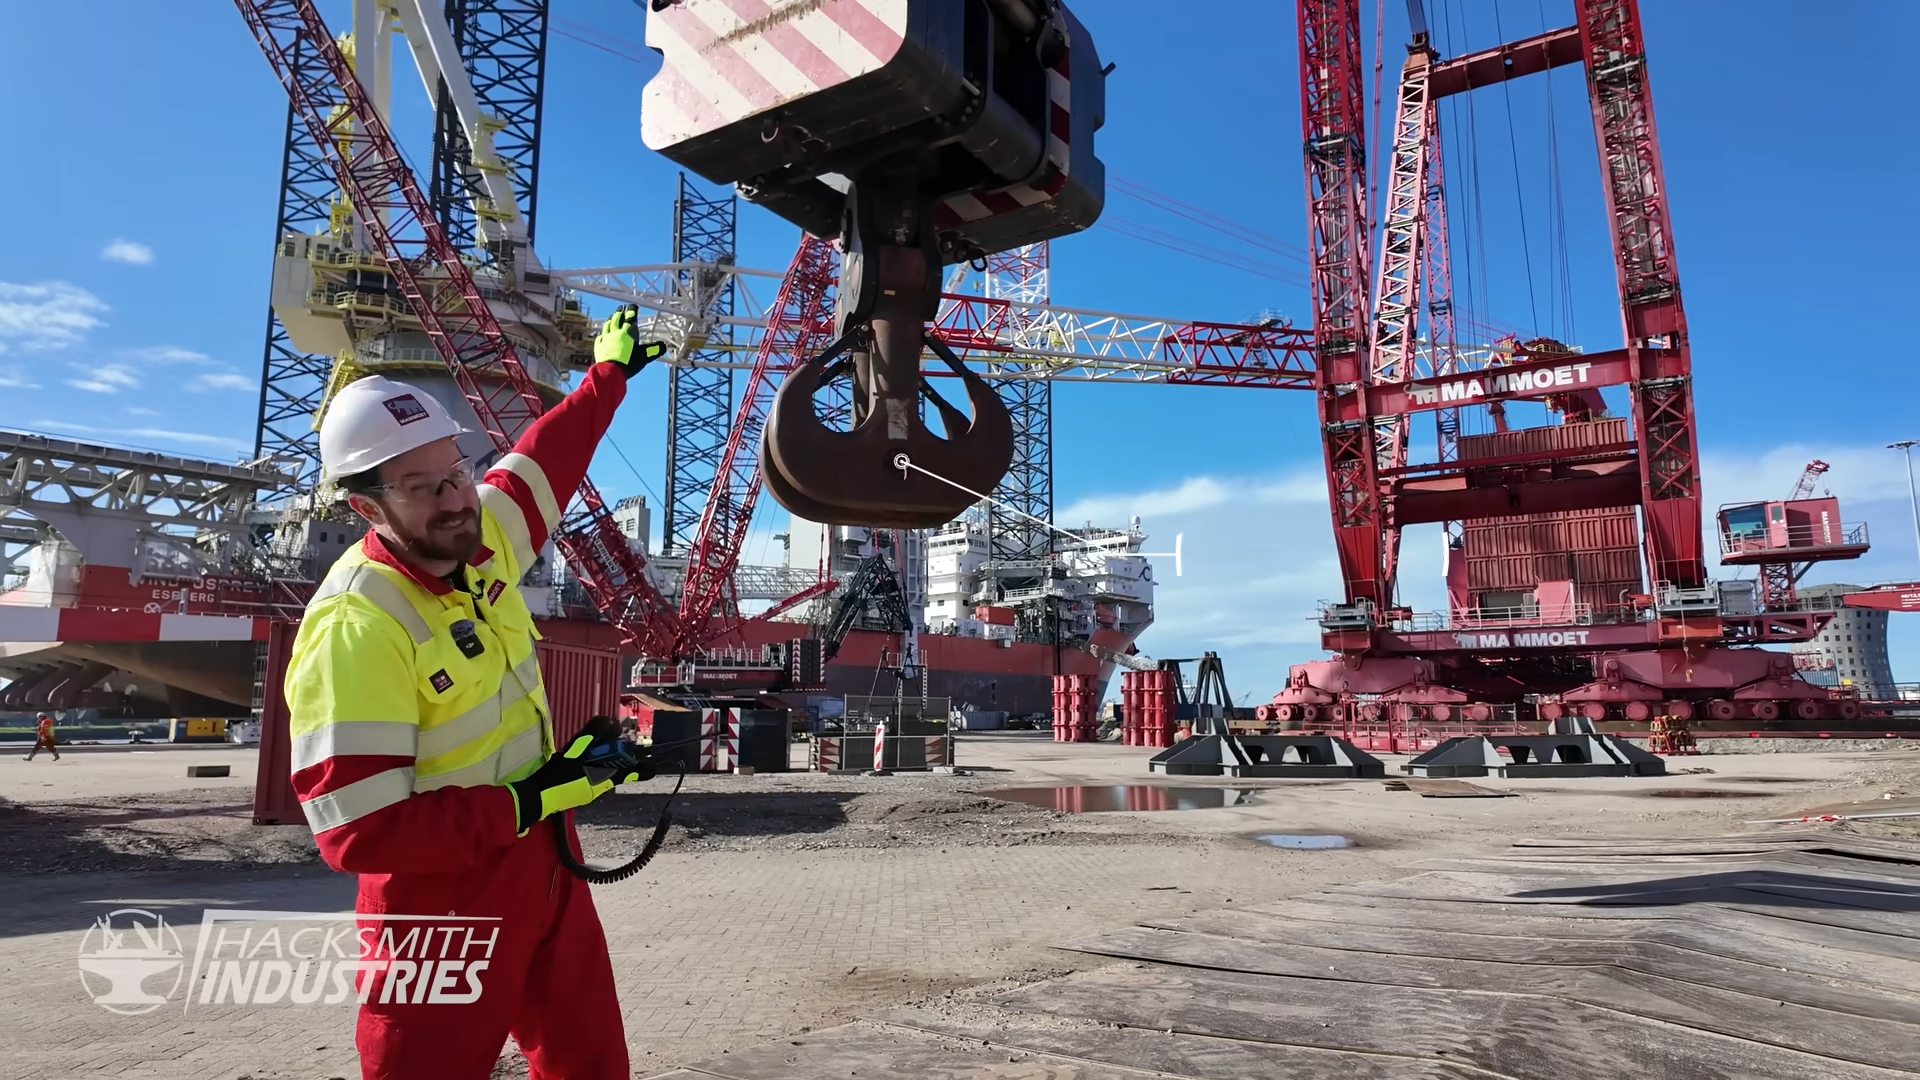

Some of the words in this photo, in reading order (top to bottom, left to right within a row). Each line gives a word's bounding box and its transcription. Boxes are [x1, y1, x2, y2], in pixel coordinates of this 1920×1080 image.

[1441, 362, 1592, 402] MAMMOET
[399, 412, 427, 424] MAMMOET
[152, 589, 215, 603] ESBERG
[1479, 630, 1590, 648] MAMMOET
